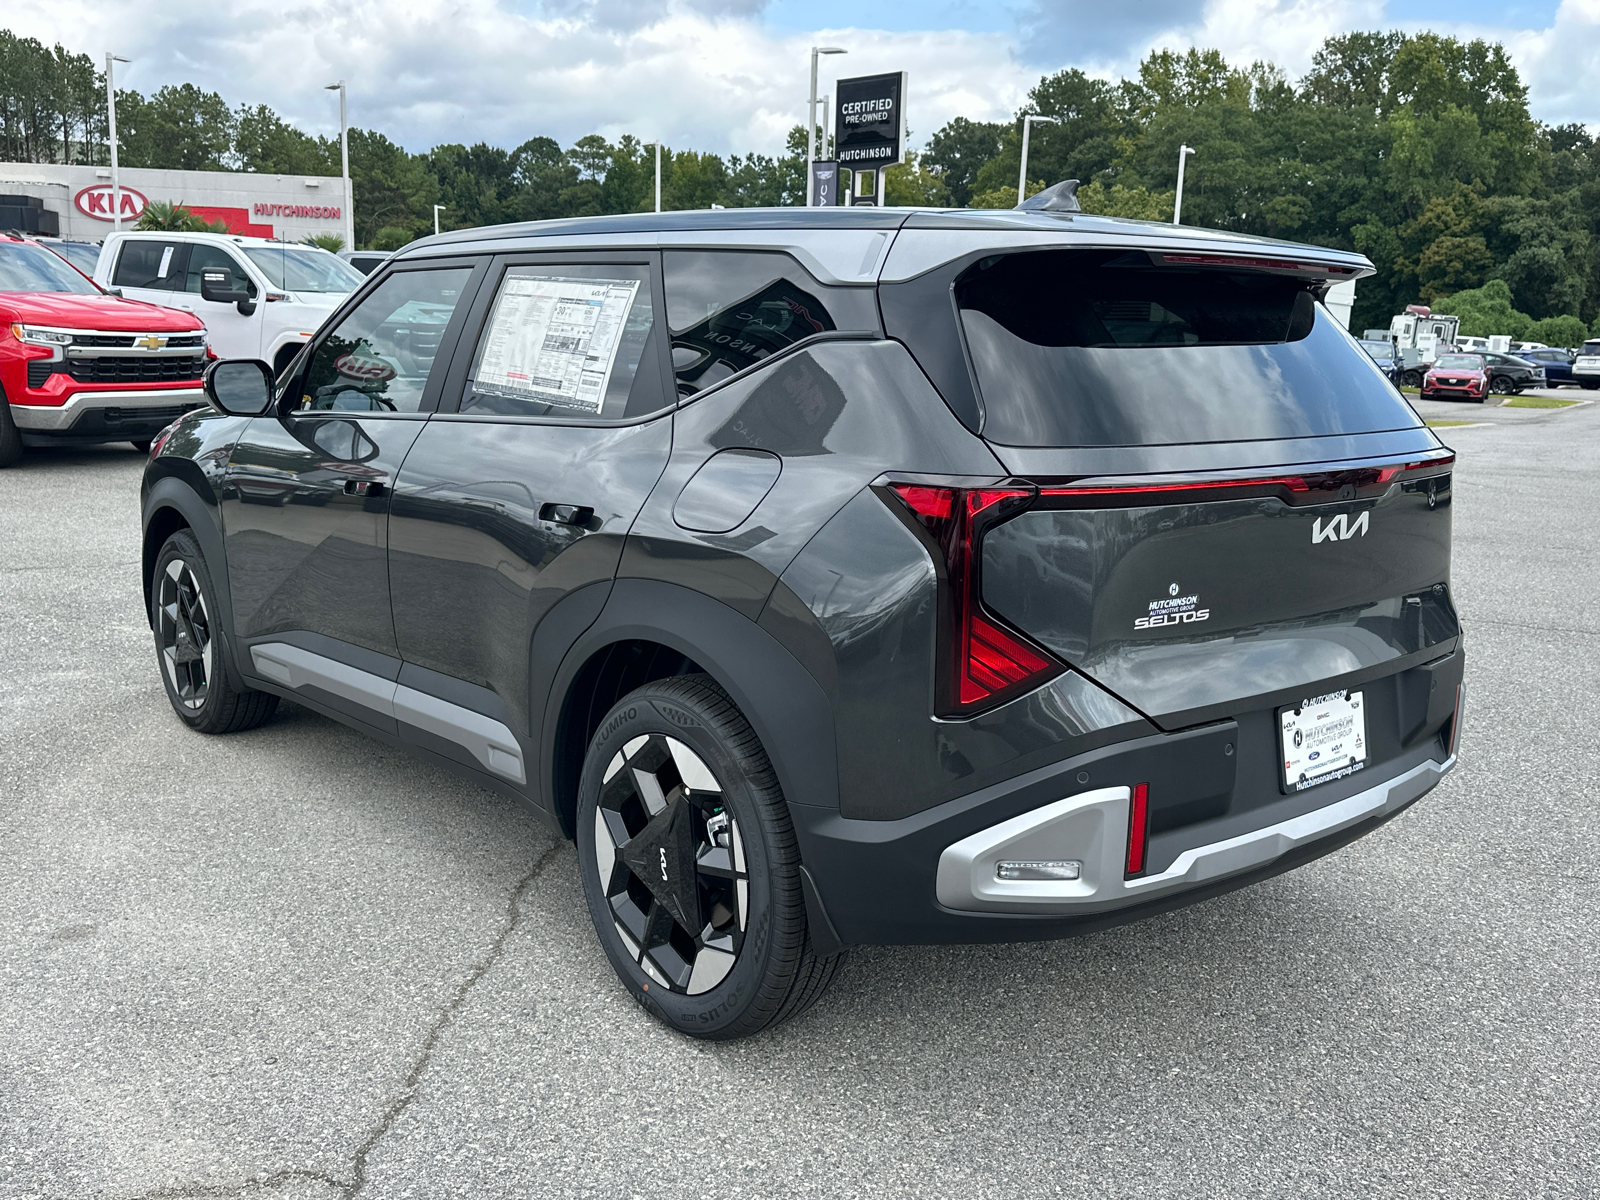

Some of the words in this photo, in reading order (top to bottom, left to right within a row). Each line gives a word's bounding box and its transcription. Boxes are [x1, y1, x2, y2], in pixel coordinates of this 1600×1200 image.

[842, 98, 893, 115] CERTIFIED
[845, 111, 888, 124] PRE-OWNED
[840, 146, 892, 161] HUTCHINSON
[87, 192, 138, 215] KIA
[253, 202, 341, 219] HUTCHINSON
[1312, 510, 1369, 544] KIA
[1148, 595, 1198, 610] HUTCHINSON
[1149, 606, 1179, 616] AUTOMOTIVE
[1179, 604, 1195, 612] GROUP
[1134, 609, 1210, 630] SELTOS
[1309, 688, 1348, 706] HUTCHINSON
[594, 707, 638, 751] KUMHO
[1305, 715, 1353, 742] HUTCHINSON
[1306, 733, 1337, 749] AUTOMOTIVE
[1337, 728, 1352, 739] GROUP
[1295, 762, 1364, 791] Hutchinsonautogroup.com
[698, 981, 745, 1024] SOLUS
